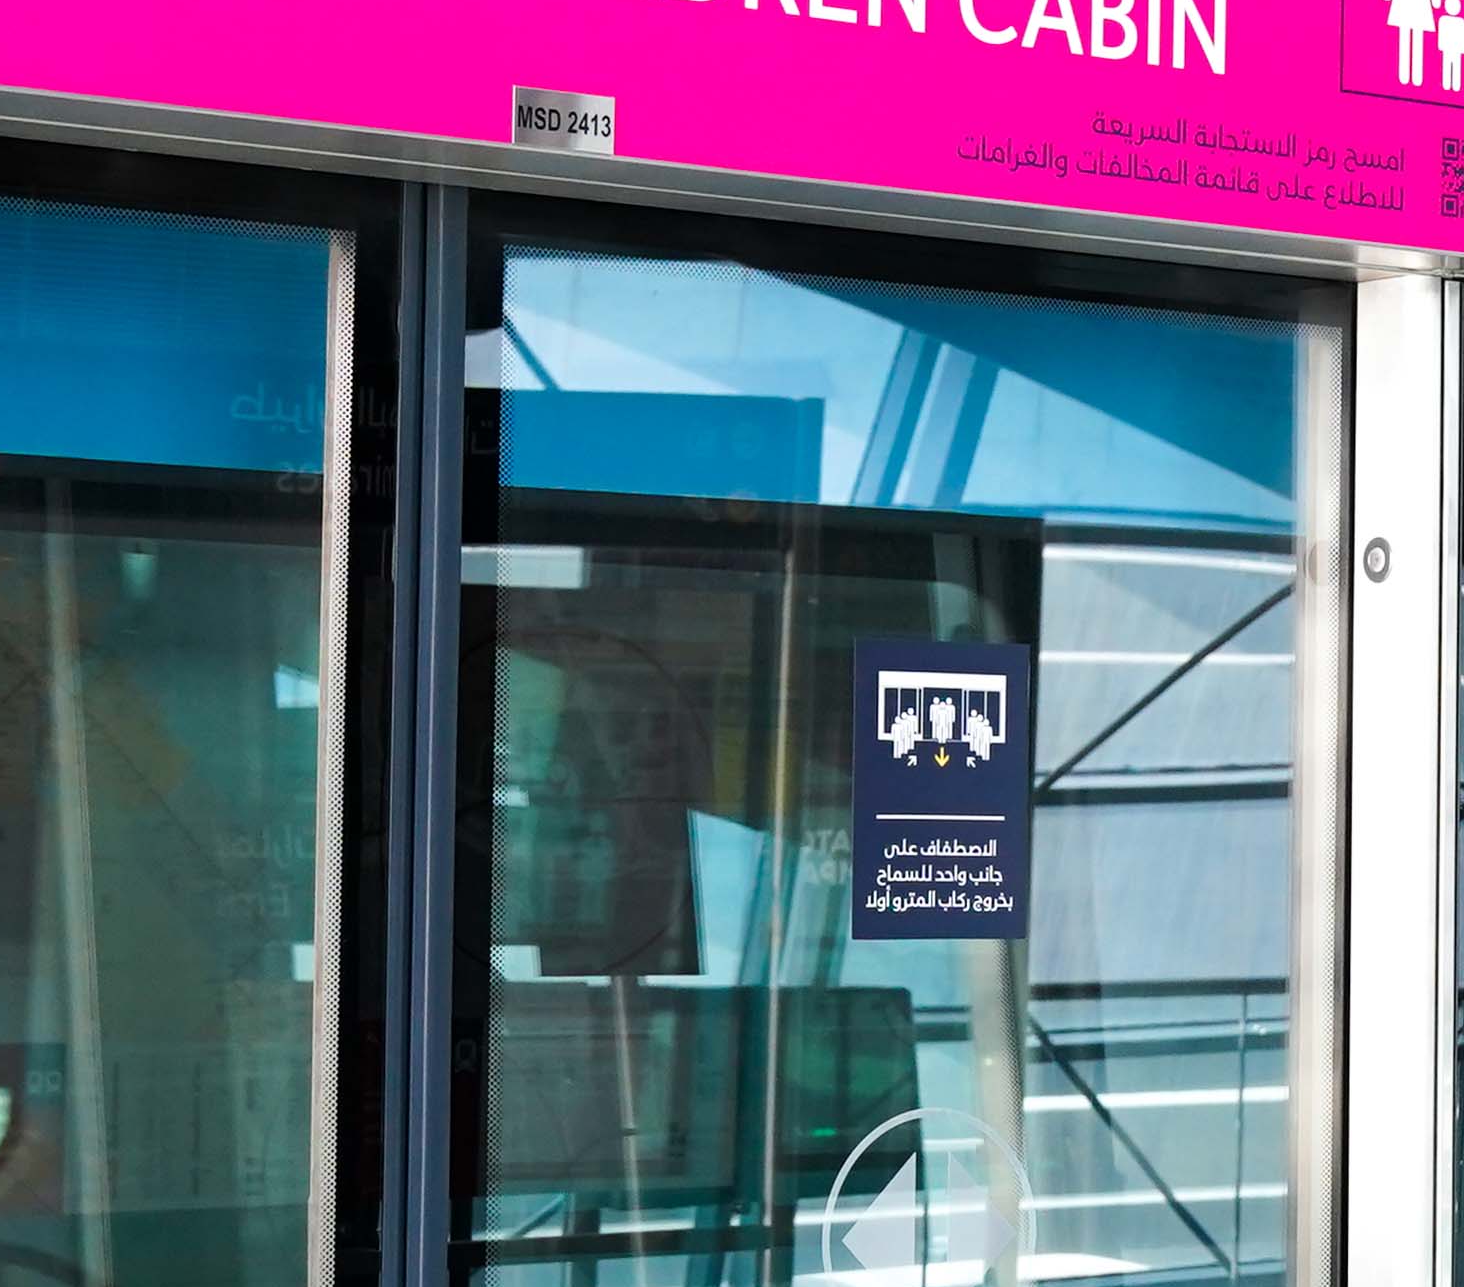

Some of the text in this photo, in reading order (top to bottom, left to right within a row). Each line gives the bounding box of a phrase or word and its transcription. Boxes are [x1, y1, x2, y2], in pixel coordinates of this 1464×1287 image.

[517, 104, 613, 142] MSD 2413
[1091, 110, 1188, 147] السريعة
[876, 864, 1004, 886] جانب واحد للسماح
[892, 889, 937, 913] المترو
[937, 890, 972, 912] ركاب
[972, 893, 1015, 912] بخروج
